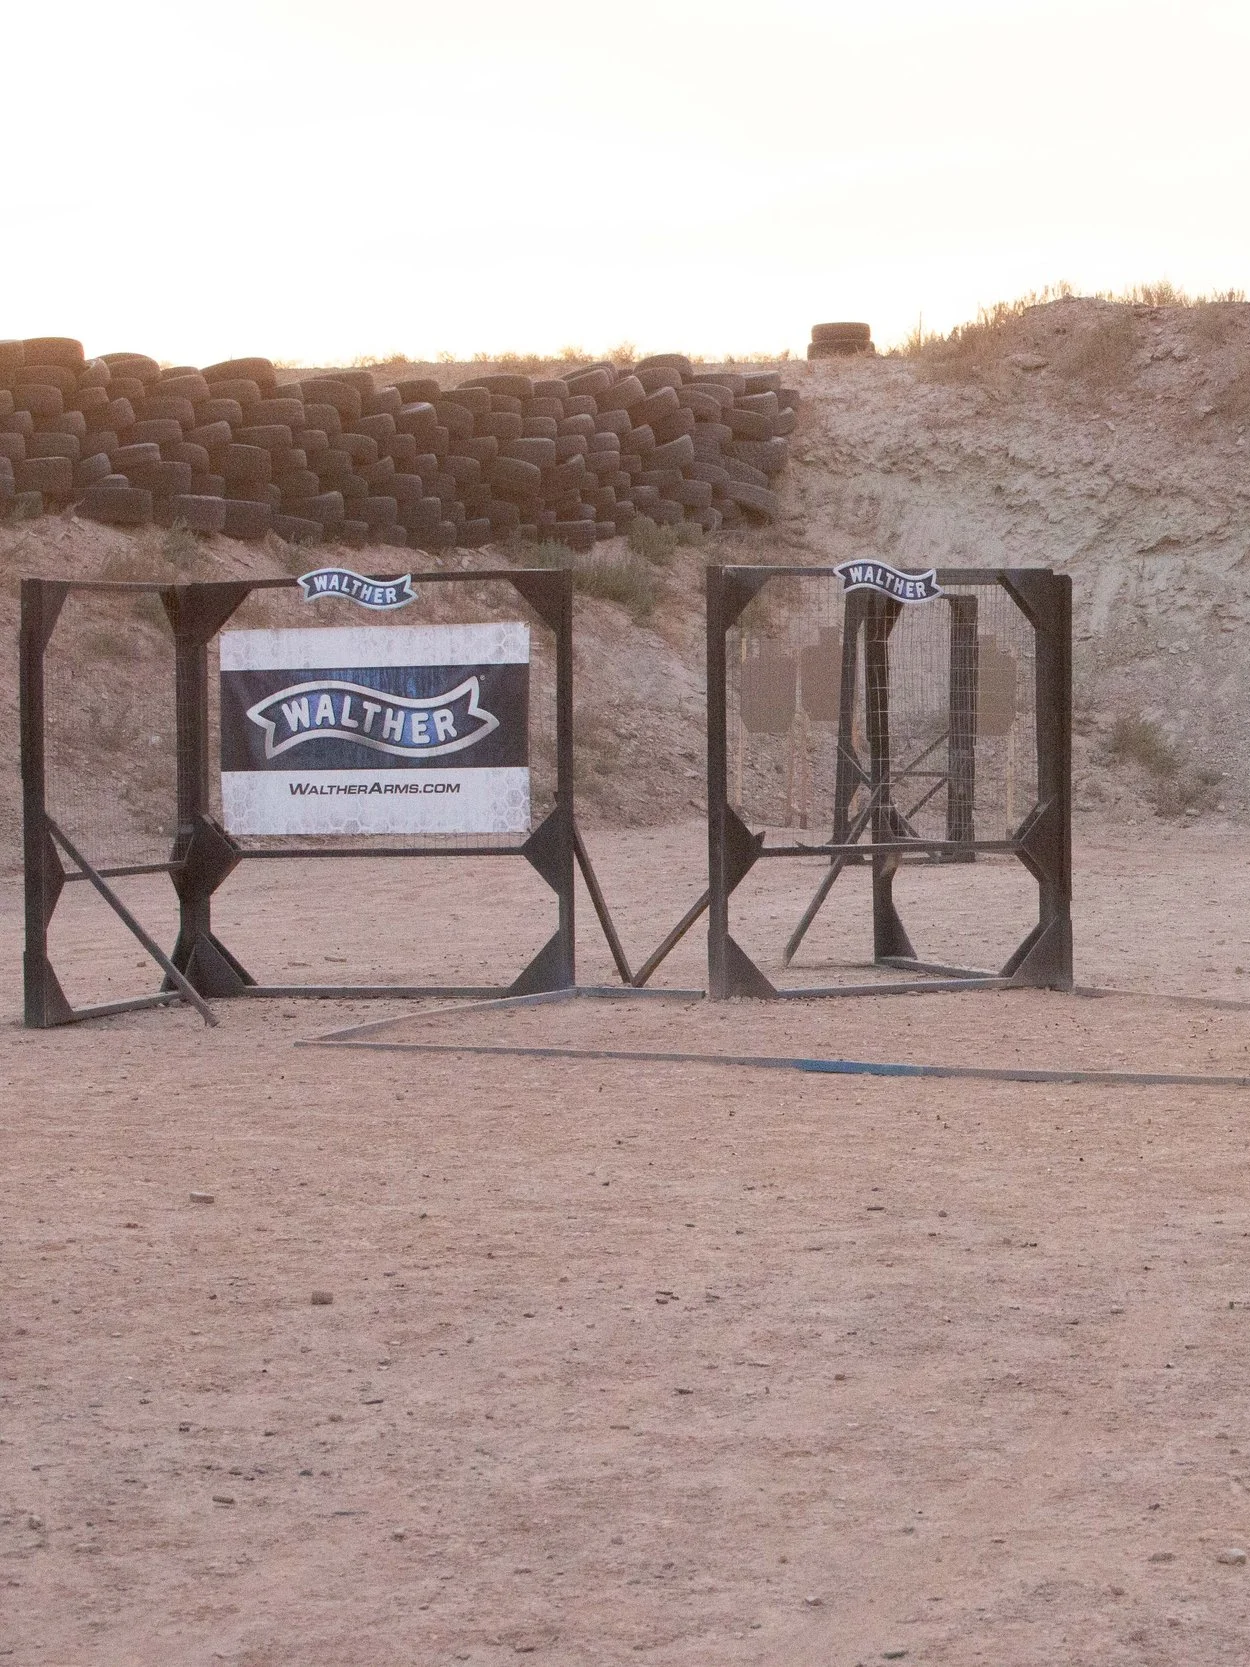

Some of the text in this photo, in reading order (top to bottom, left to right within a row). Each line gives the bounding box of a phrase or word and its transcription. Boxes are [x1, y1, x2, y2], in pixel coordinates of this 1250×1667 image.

[313, 576, 397, 604] WALTHER
[849, 566, 927, 598] WALTHER
[281, 694, 458, 744] WALTHER
